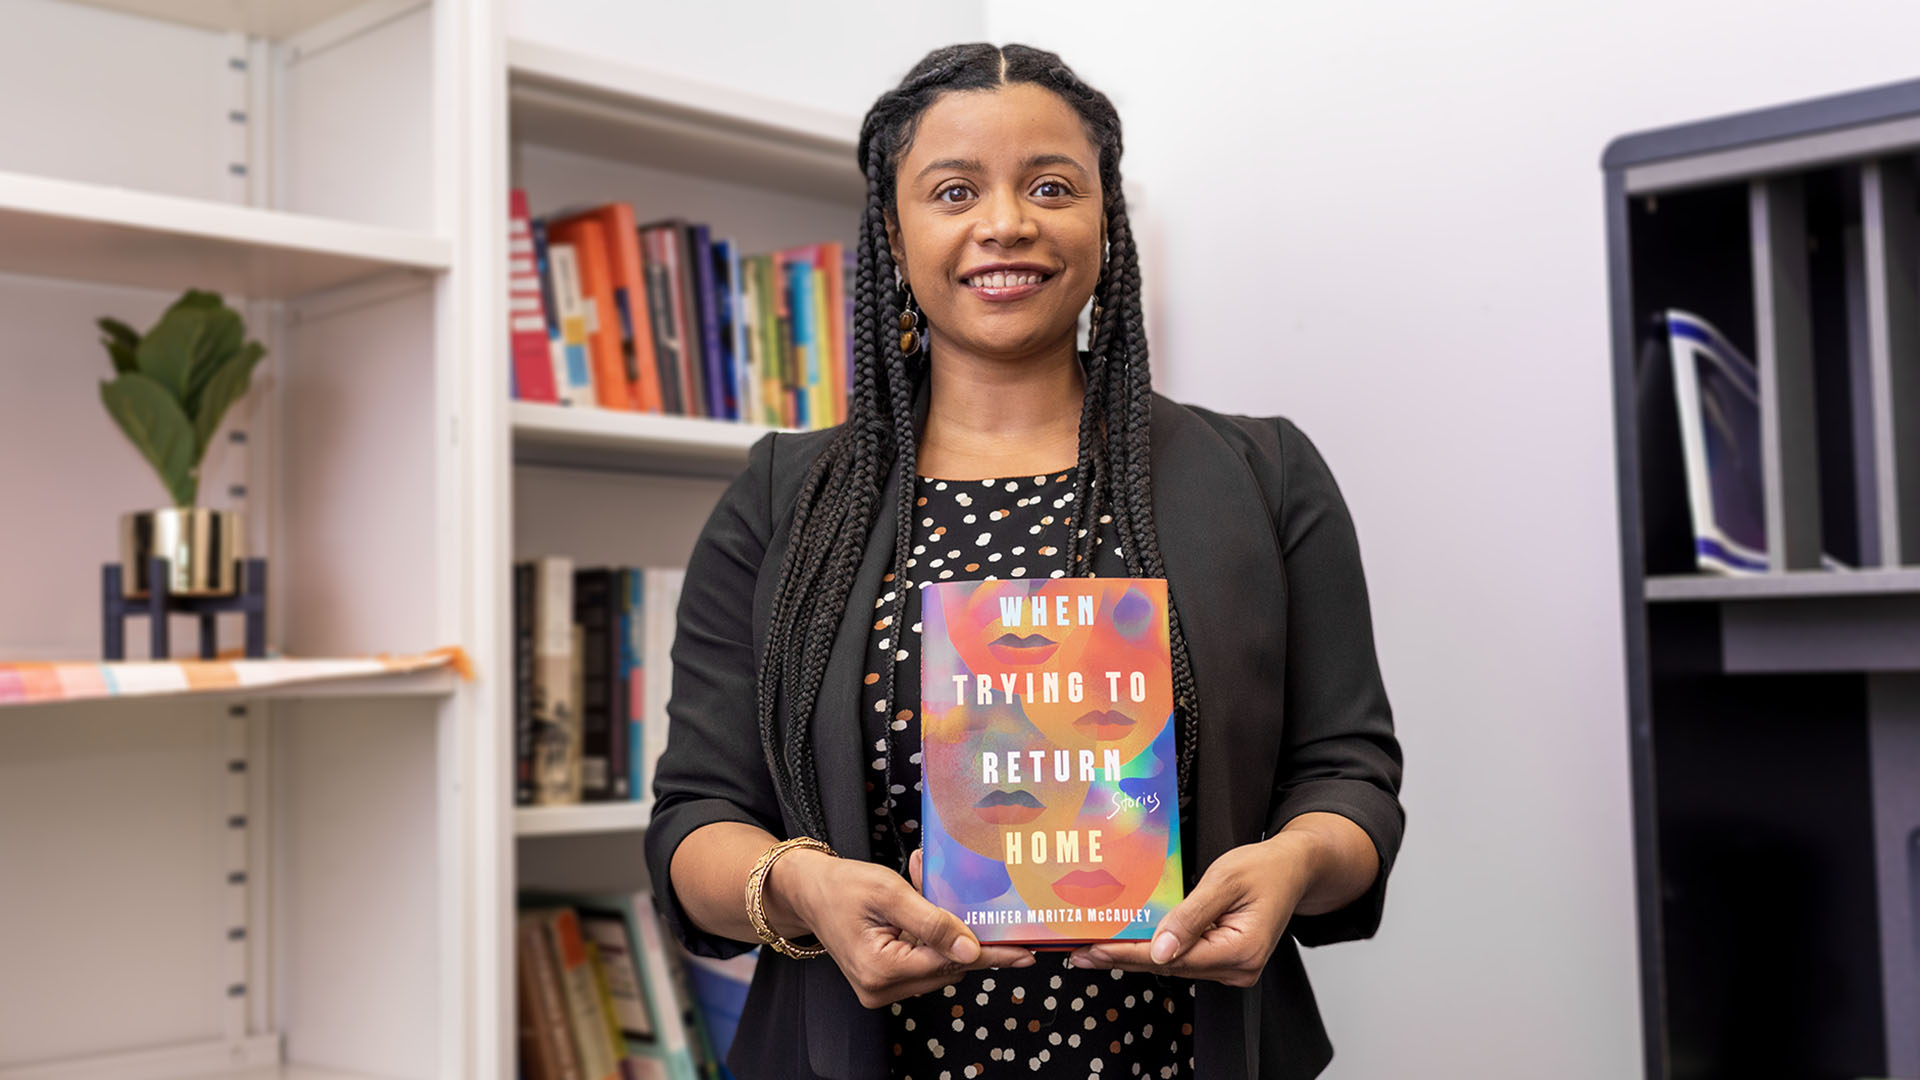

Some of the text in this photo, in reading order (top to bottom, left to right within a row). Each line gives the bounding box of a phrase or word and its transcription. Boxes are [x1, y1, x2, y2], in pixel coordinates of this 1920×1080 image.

[1000, 595, 1094, 627] WHEN
[953, 670, 1146, 705] TRYING TO
[982, 749, 1121, 784] RETURN
[1106, 791, 1161, 820] Stories
[1006, 830, 1102, 864] HOME
[964, 908, 1151, 925] JENNIFER MARITZA McCAULEY
